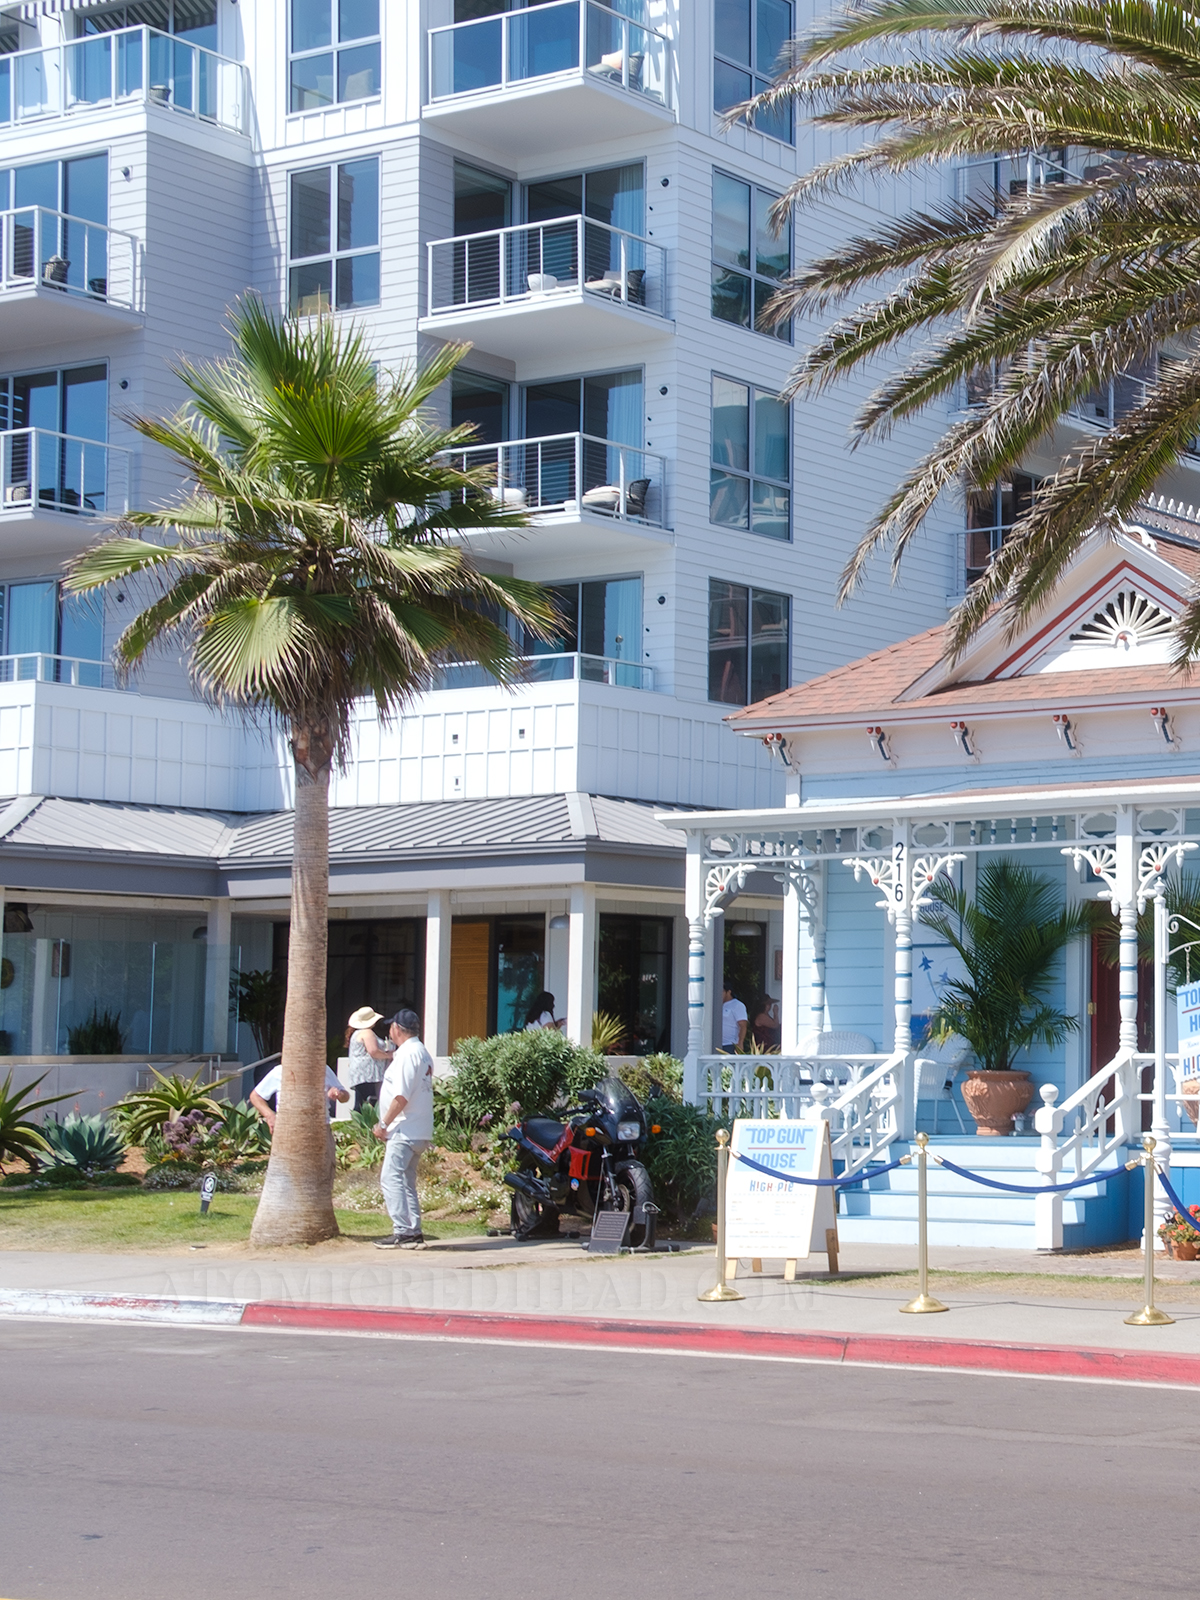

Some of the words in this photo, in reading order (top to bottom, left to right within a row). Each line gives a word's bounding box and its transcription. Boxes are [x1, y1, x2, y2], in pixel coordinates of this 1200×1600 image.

[895, 842, 904, 902] 216
[746, 1128, 775, 1144] TOP
[777, 1128, 813, 1144] GUN
